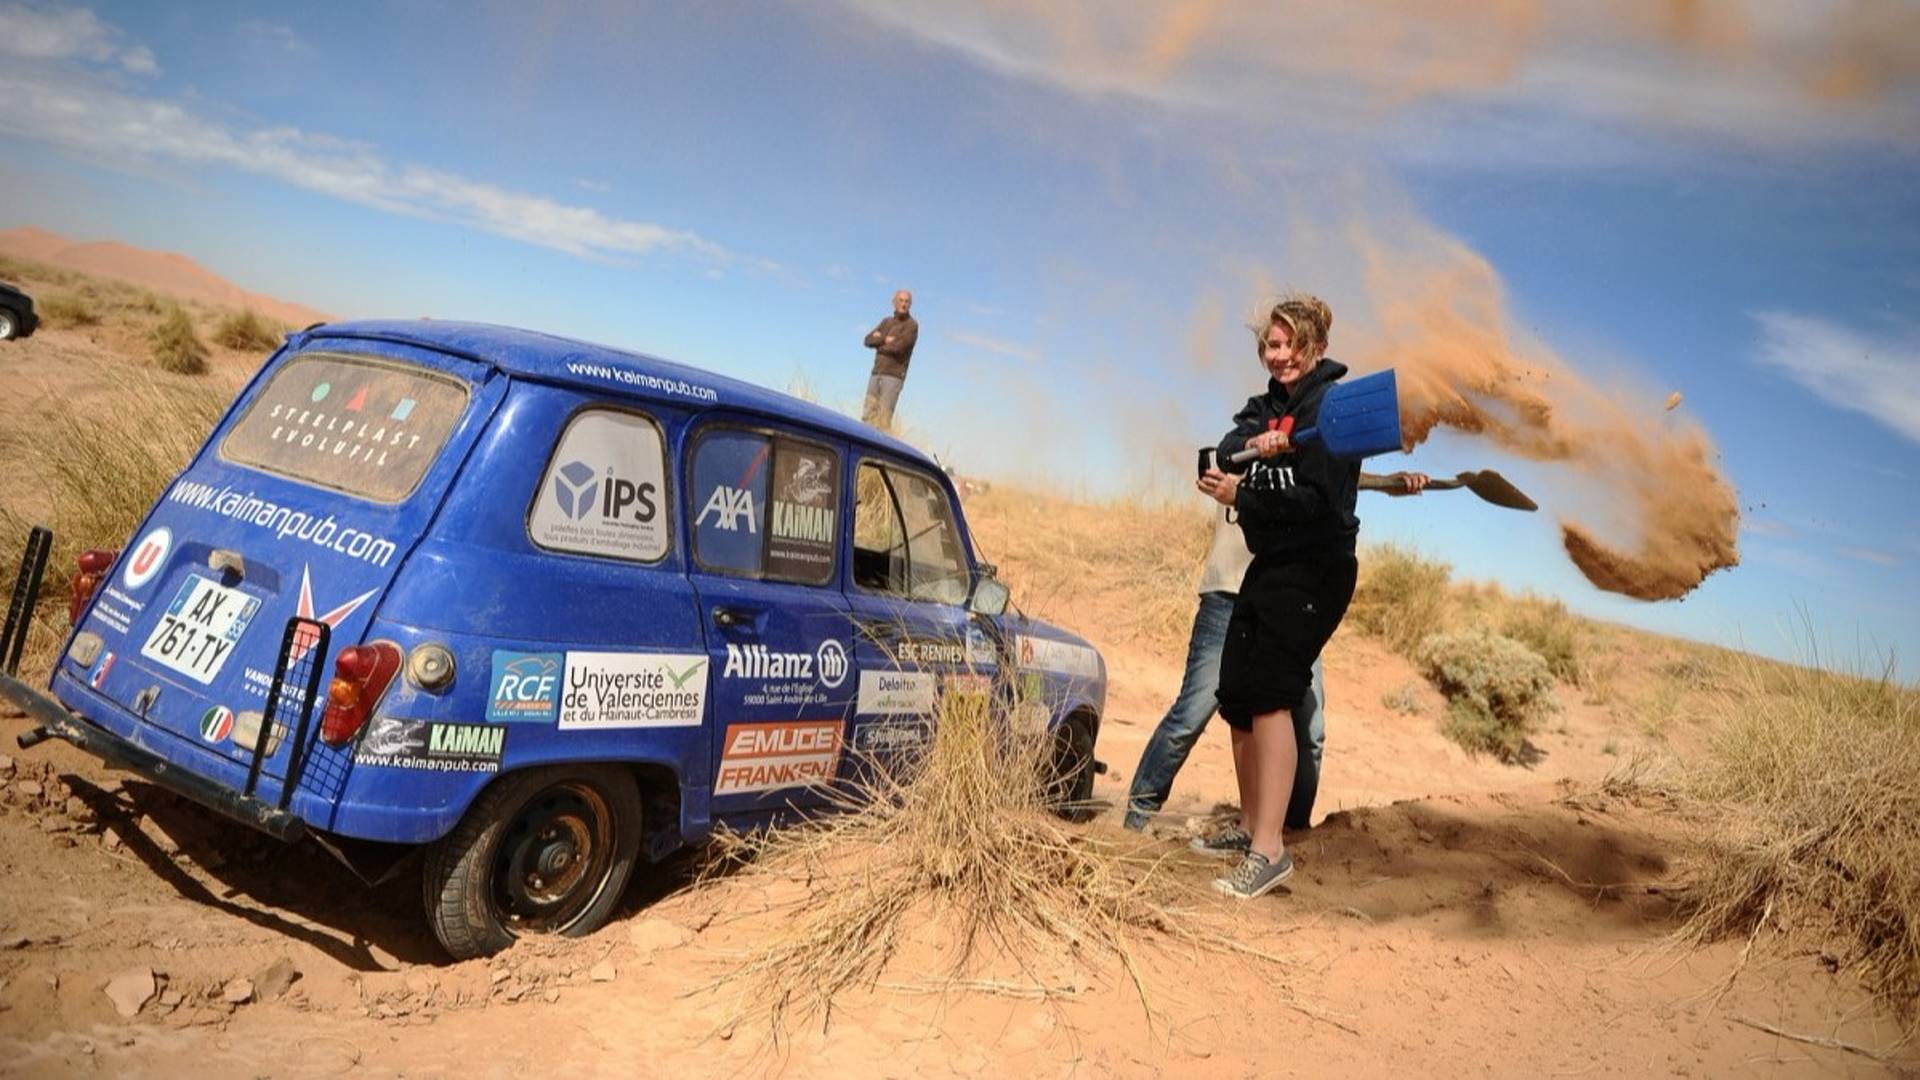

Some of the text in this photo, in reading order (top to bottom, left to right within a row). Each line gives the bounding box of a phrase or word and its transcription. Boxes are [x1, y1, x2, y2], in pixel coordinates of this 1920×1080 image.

[270, 404, 420, 449] STEELPLAST
[271, 426, 388, 466] EVOLUFIL
[169, 478, 397, 568] www.kaimanpub.com
[695, 485, 757, 534] AXA
[132, 542, 163, 576] U
[723, 643, 813, 679] Allianz
[495, 674, 555, 701] RCF
[571, 664, 664, 690] Université
[564, 687, 700, 709] de Valenciennes
[563, 707, 576, 722] et
[580, 707, 595, 722] du
[728, 726, 835, 756] EMUGE
[354, 753, 499, 773] www.kaimanpub.com
[719, 760, 829, 789] FRANKEN
